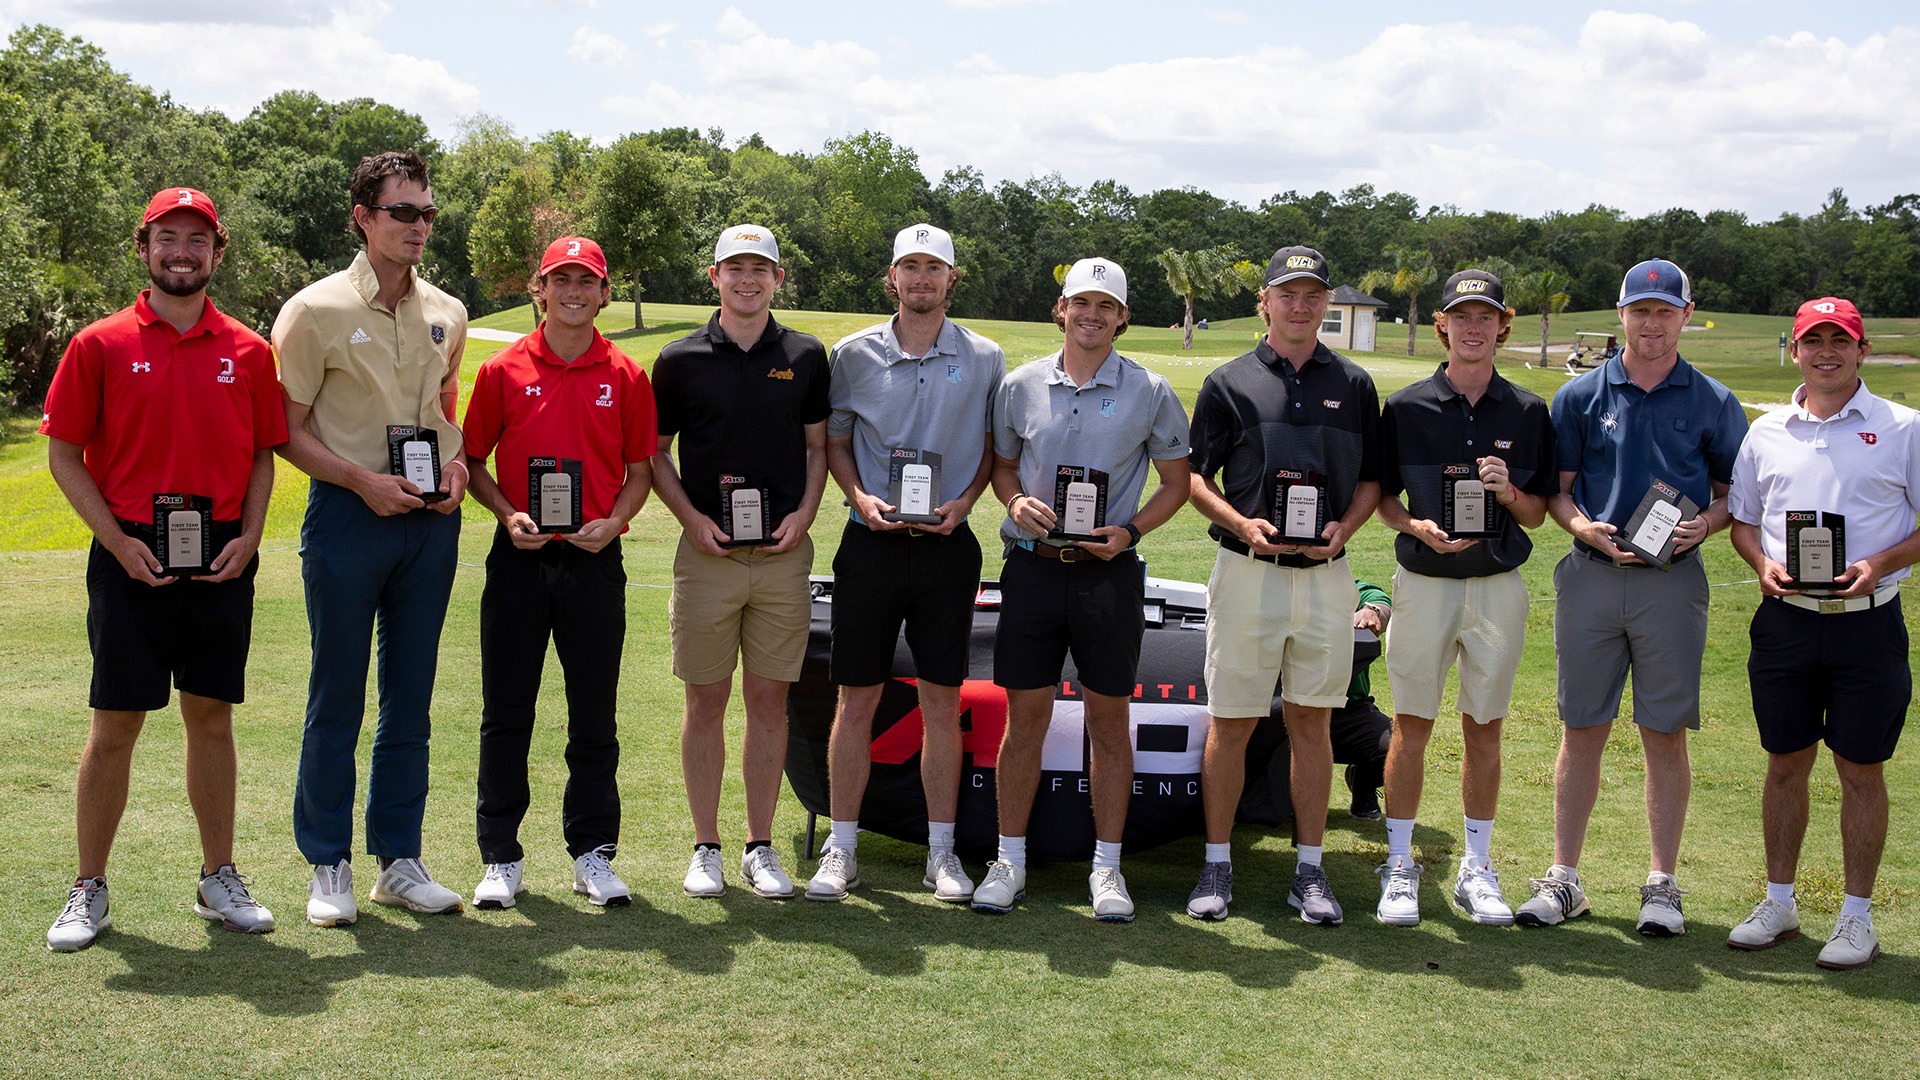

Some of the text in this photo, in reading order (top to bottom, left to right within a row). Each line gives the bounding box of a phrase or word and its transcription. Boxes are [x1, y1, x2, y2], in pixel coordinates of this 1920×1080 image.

[217, 375, 235, 384] GOLF
[595, 399, 613, 407] GOLF
[1664, 516, 1675, 524] TEAM
